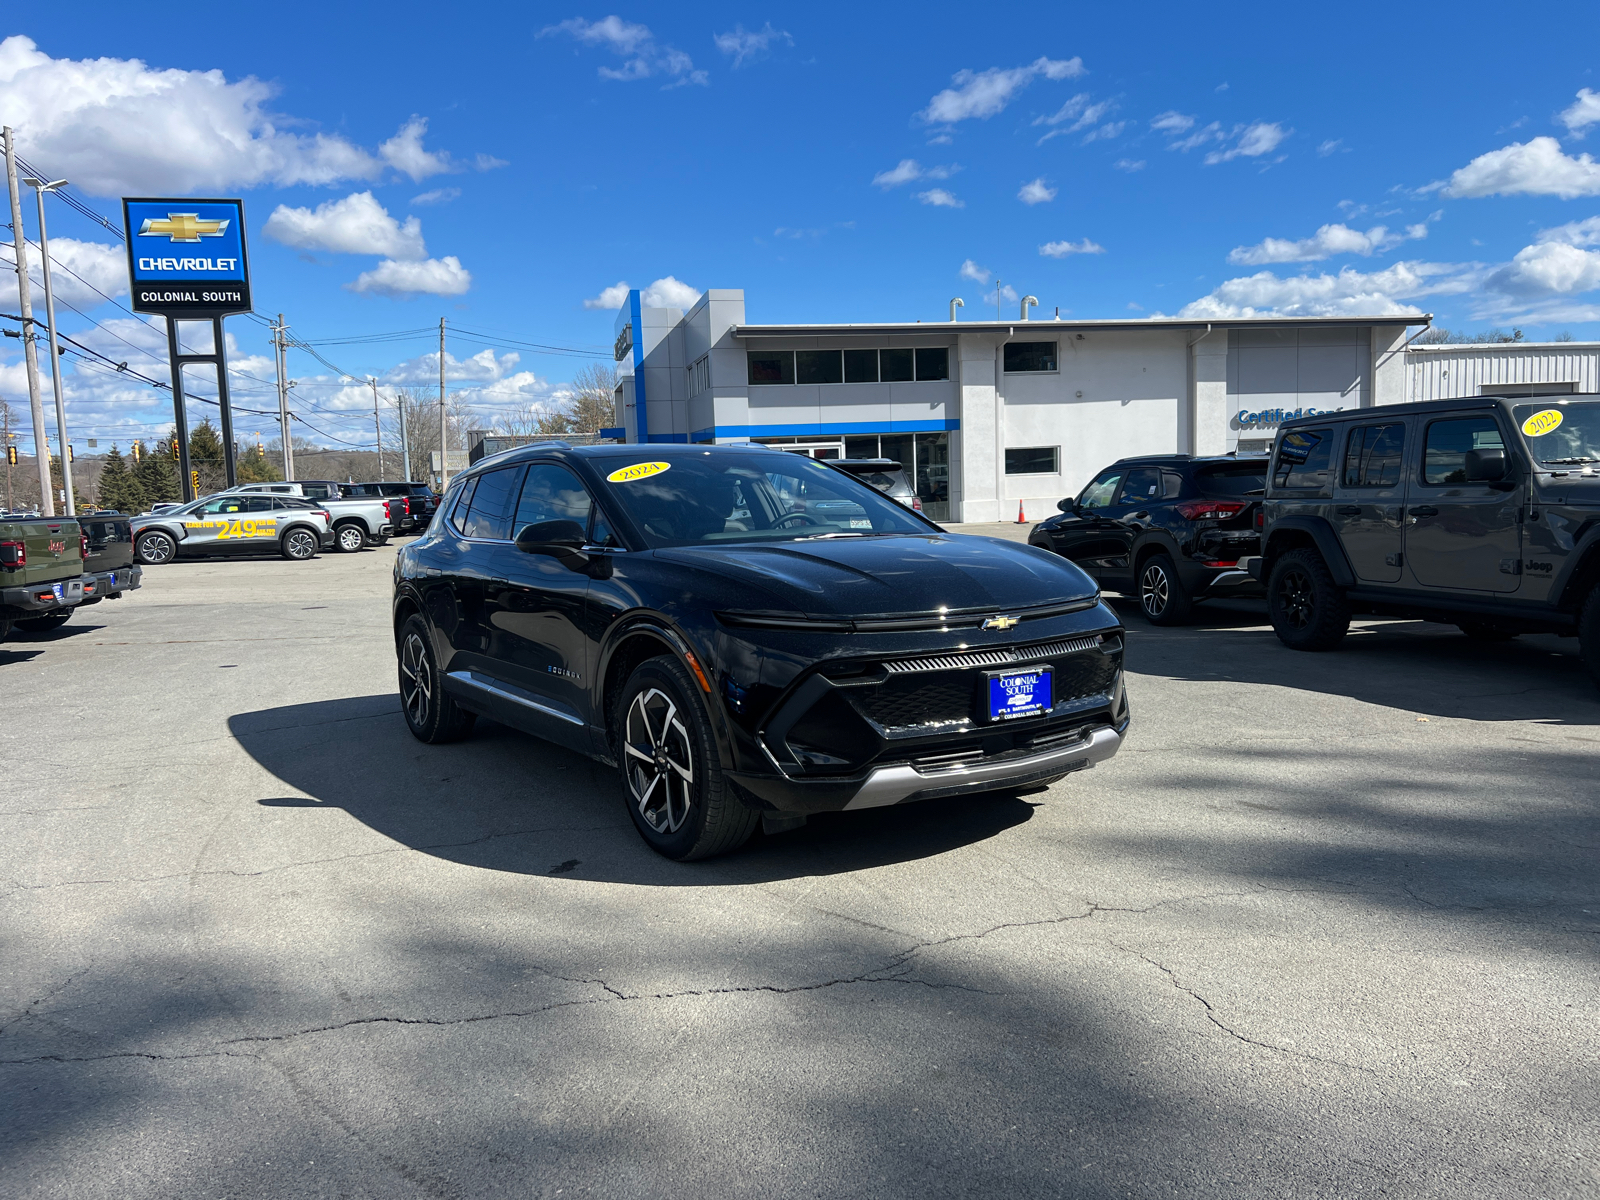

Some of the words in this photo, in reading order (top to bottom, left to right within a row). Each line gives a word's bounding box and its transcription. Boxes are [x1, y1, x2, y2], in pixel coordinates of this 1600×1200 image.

[138, 257, 237, 271] CHEVROLET
[141, 291, 199, 302] COLONIAL
[202, 291, 241, 302] SOUTH
[1238, 407, 1303, 424] Certified
[1530, 412, 1557, 433] 2022
[619, 463, 660, 480] 2024
[185, 521, 203, 529] LEASE
[48, 539, 65, 555] Jeep
[1525, 559, 1553, 573] Jeep
[547, 665, 581, 680] EQUINOX
[1000, 675, 1039, 688] COLONIAL
[1006, 684, 1034, 696] SOUTH
